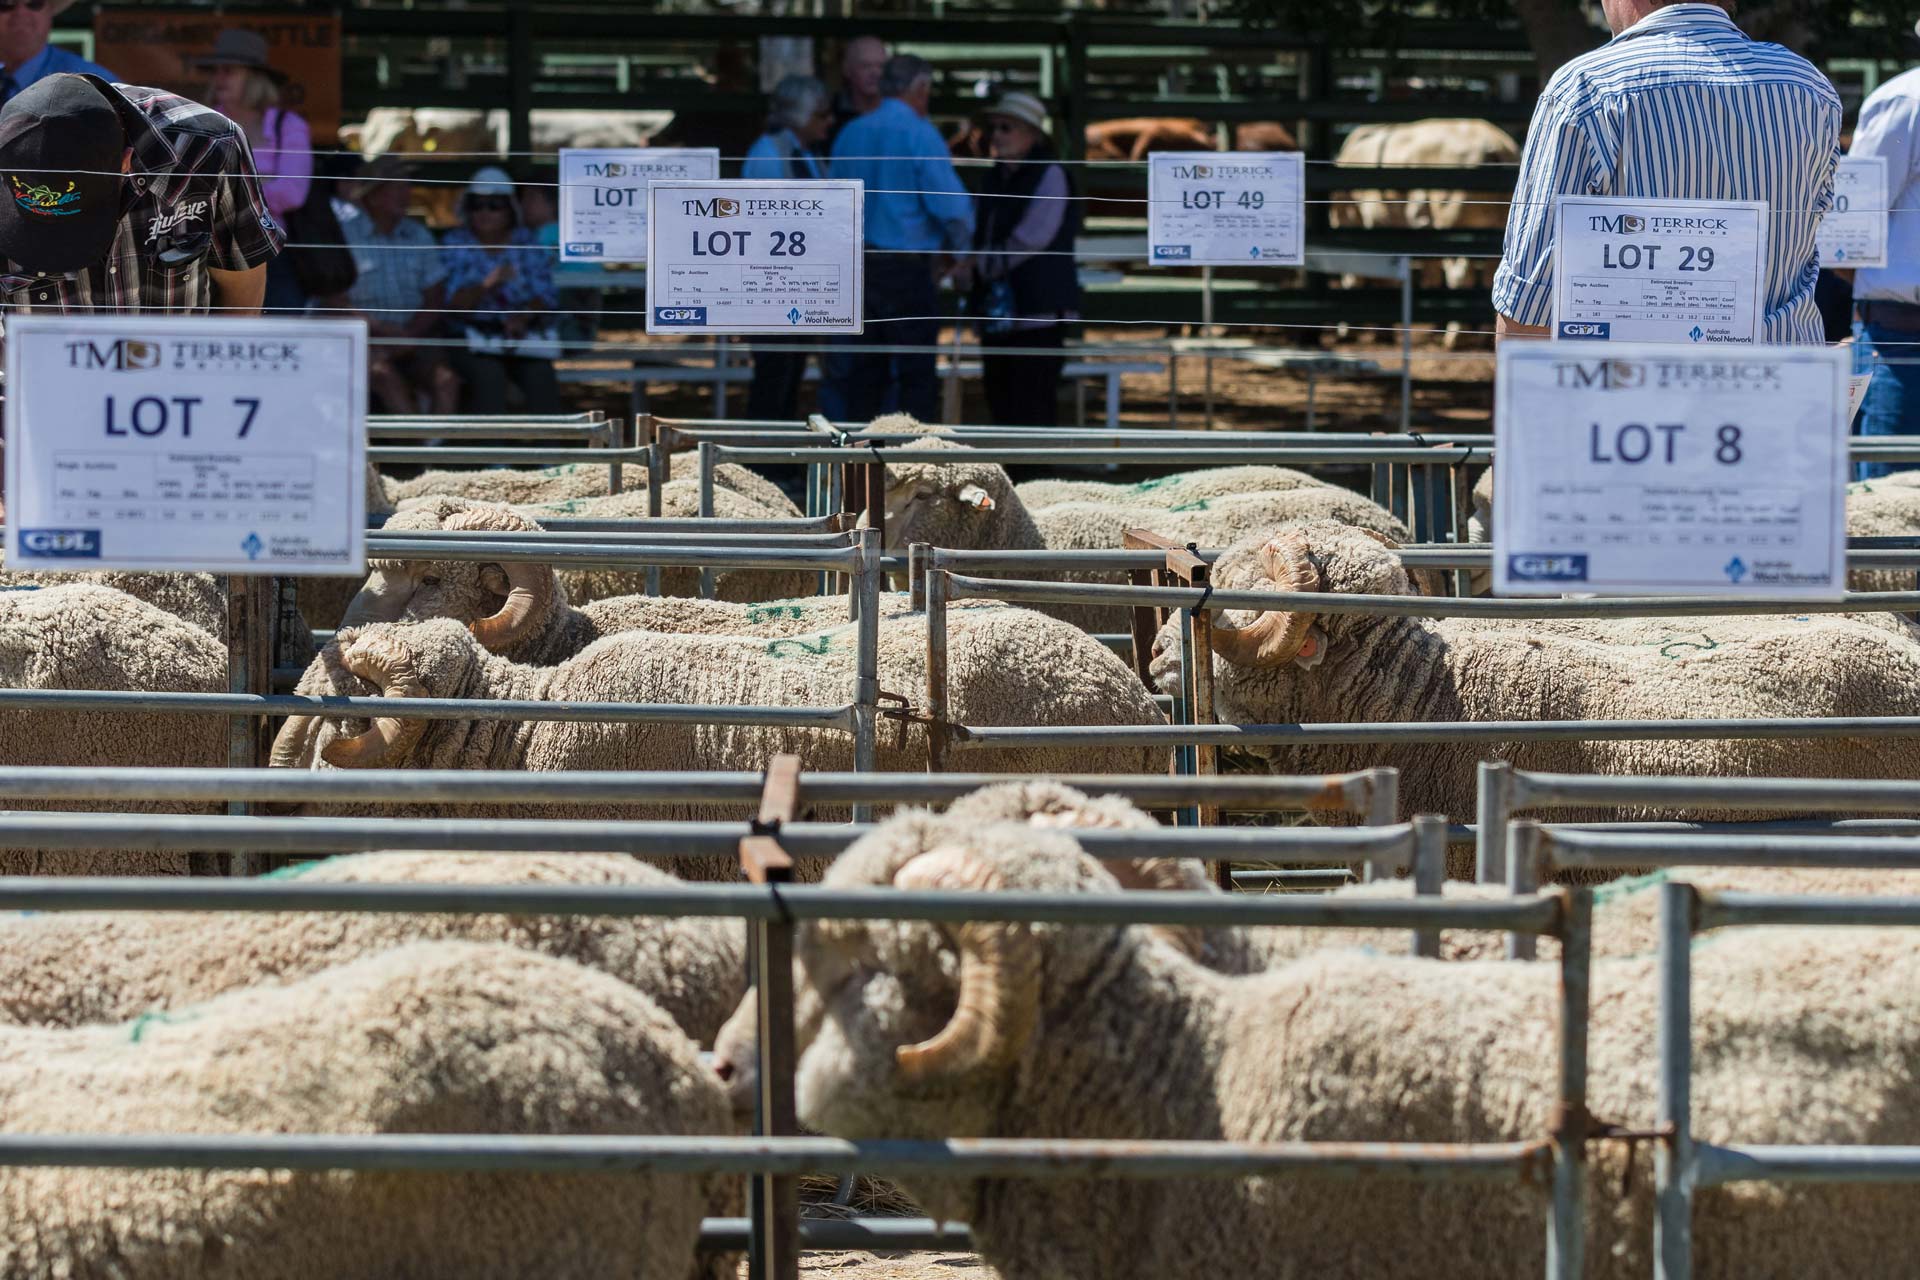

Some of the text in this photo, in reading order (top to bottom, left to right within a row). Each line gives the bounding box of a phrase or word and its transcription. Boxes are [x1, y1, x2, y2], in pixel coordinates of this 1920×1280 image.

[1218, 166, 1273, 175] TERRICK
[594, 188, 638, 207] LOT
[746, 199, 825, 210] TERRICK
[1183, 191, 1264, 209] LOT 49
[1651, 217, 1728, 229] TERRICK
[692, 230, 807, 257] LOT 28
[1603, 244, 1715, 272] LOT 29
[659, 309, 701, 321] GDL
[804, 316, 852, 324] Wool Network
[1563, 324, 1605, 336] GDL
[1706, 335, 1752, 344] Wool Network
[170, 341, 302, 361] TERRICK
[1654, 363, 1782, 381] TERRICK
[106, 396, 262, 439] LOT 7
[1589, 423, 1743, 465] LOT 8
